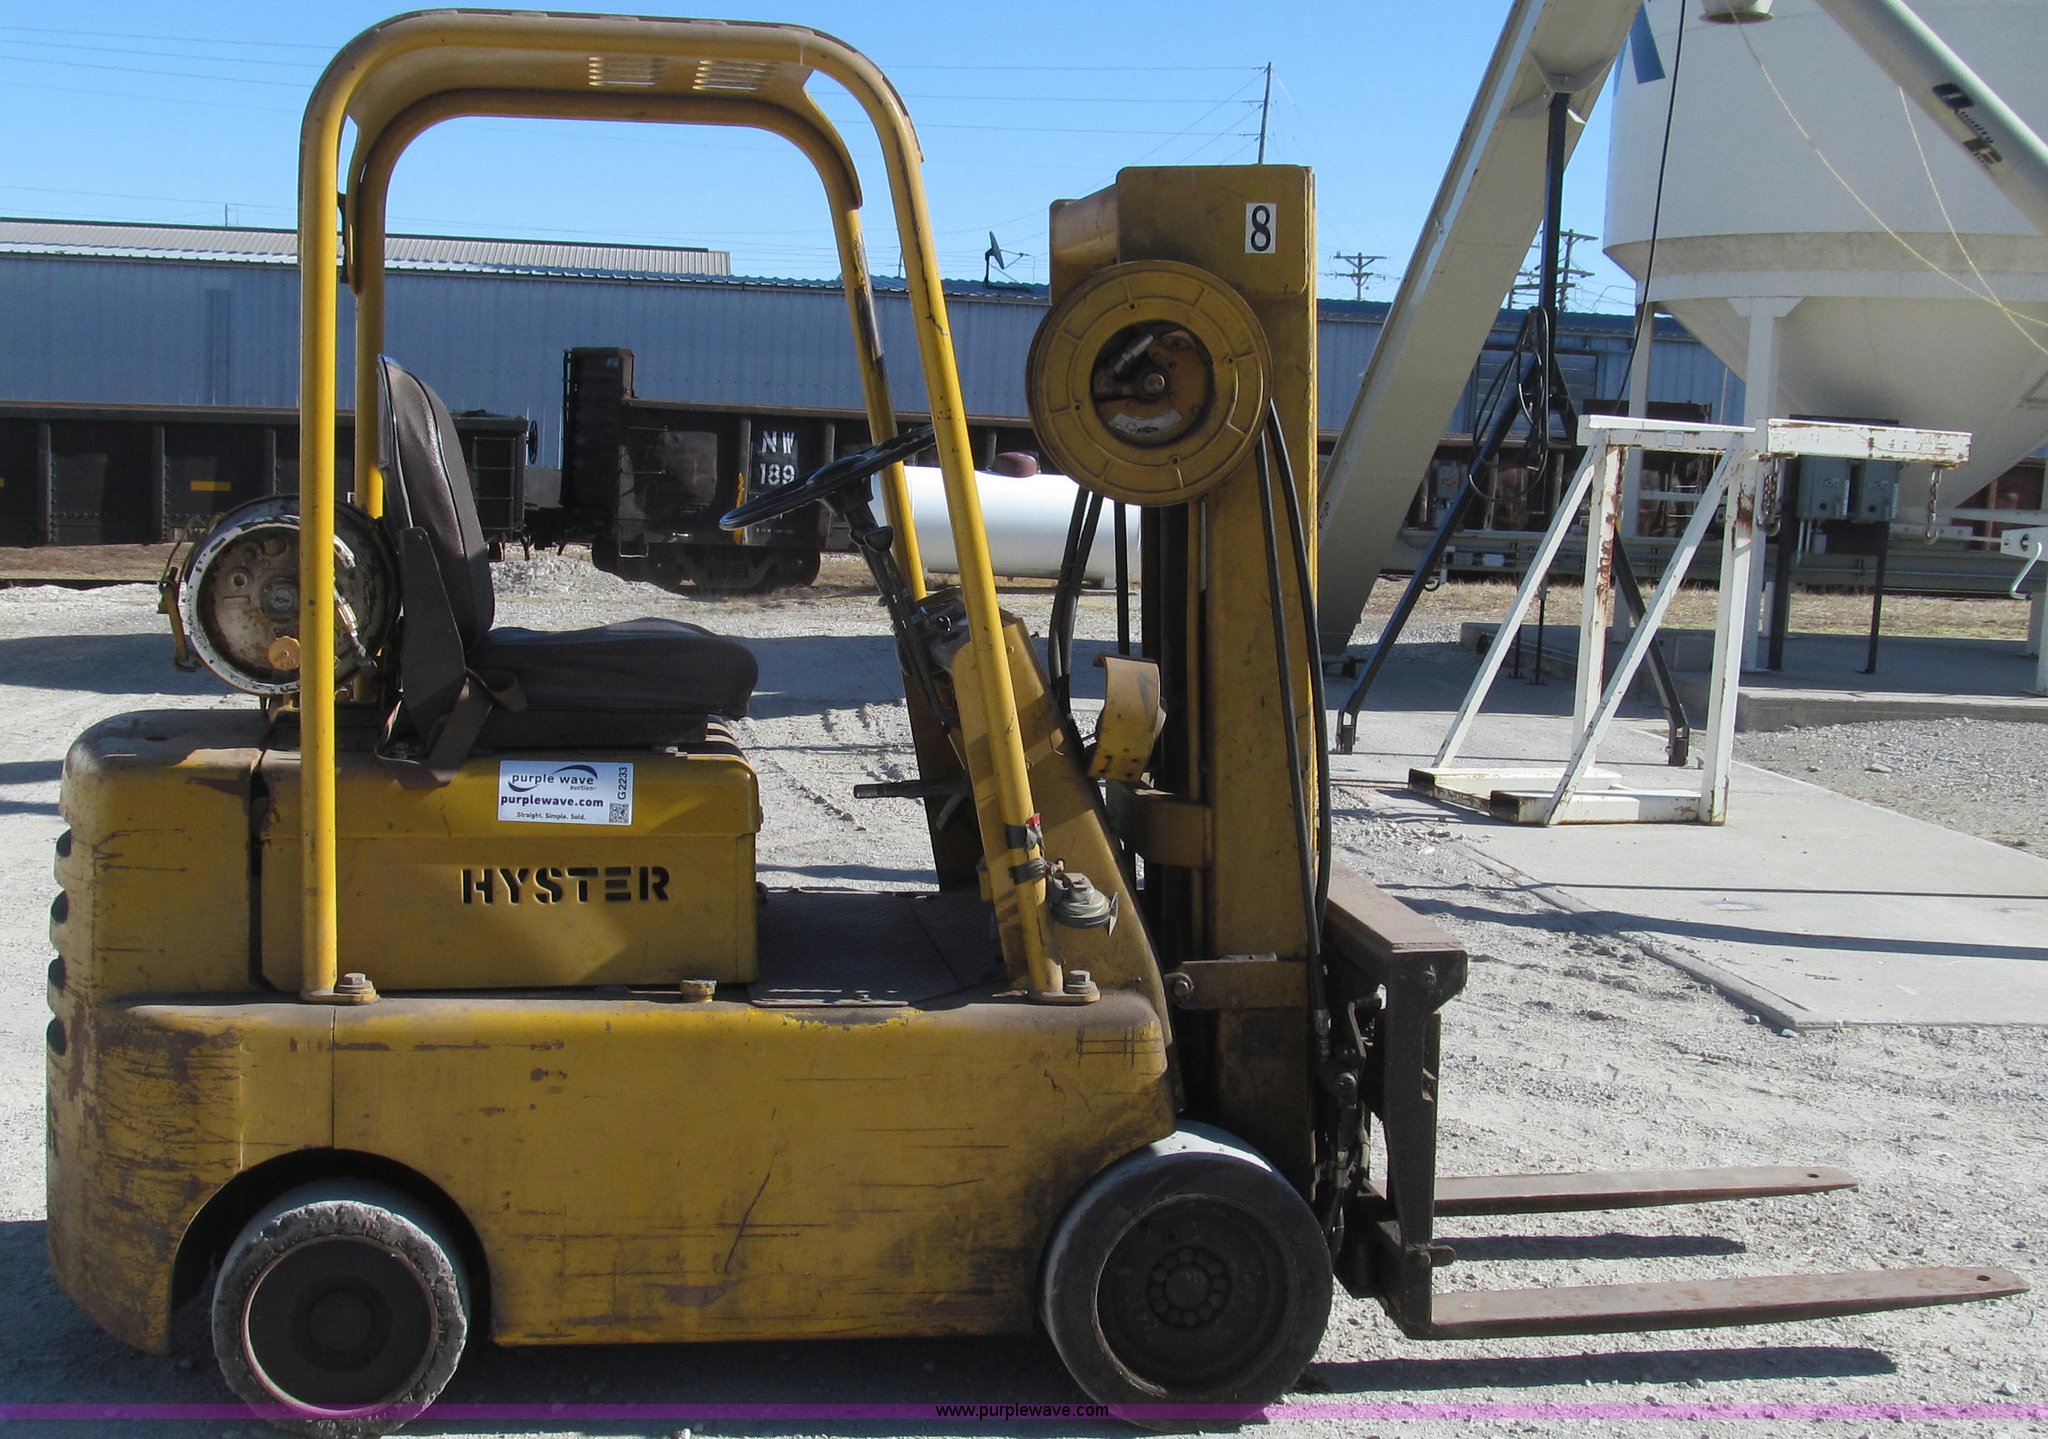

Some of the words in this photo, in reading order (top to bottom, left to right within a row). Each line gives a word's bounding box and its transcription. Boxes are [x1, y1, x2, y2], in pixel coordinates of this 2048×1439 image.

[1251, 204, 1271, 252] 8
[512, 773, 555, 785] purple
[560, 776, 594, 785] wave
[617, 766, 628, 800] G2233
[501, 794, 604, 807] purplewave.com
[516, 811, 544, 820] Straight.
[545, 812, 569, 820] Simple.
[461, 866, 670, 905] HYSTER
